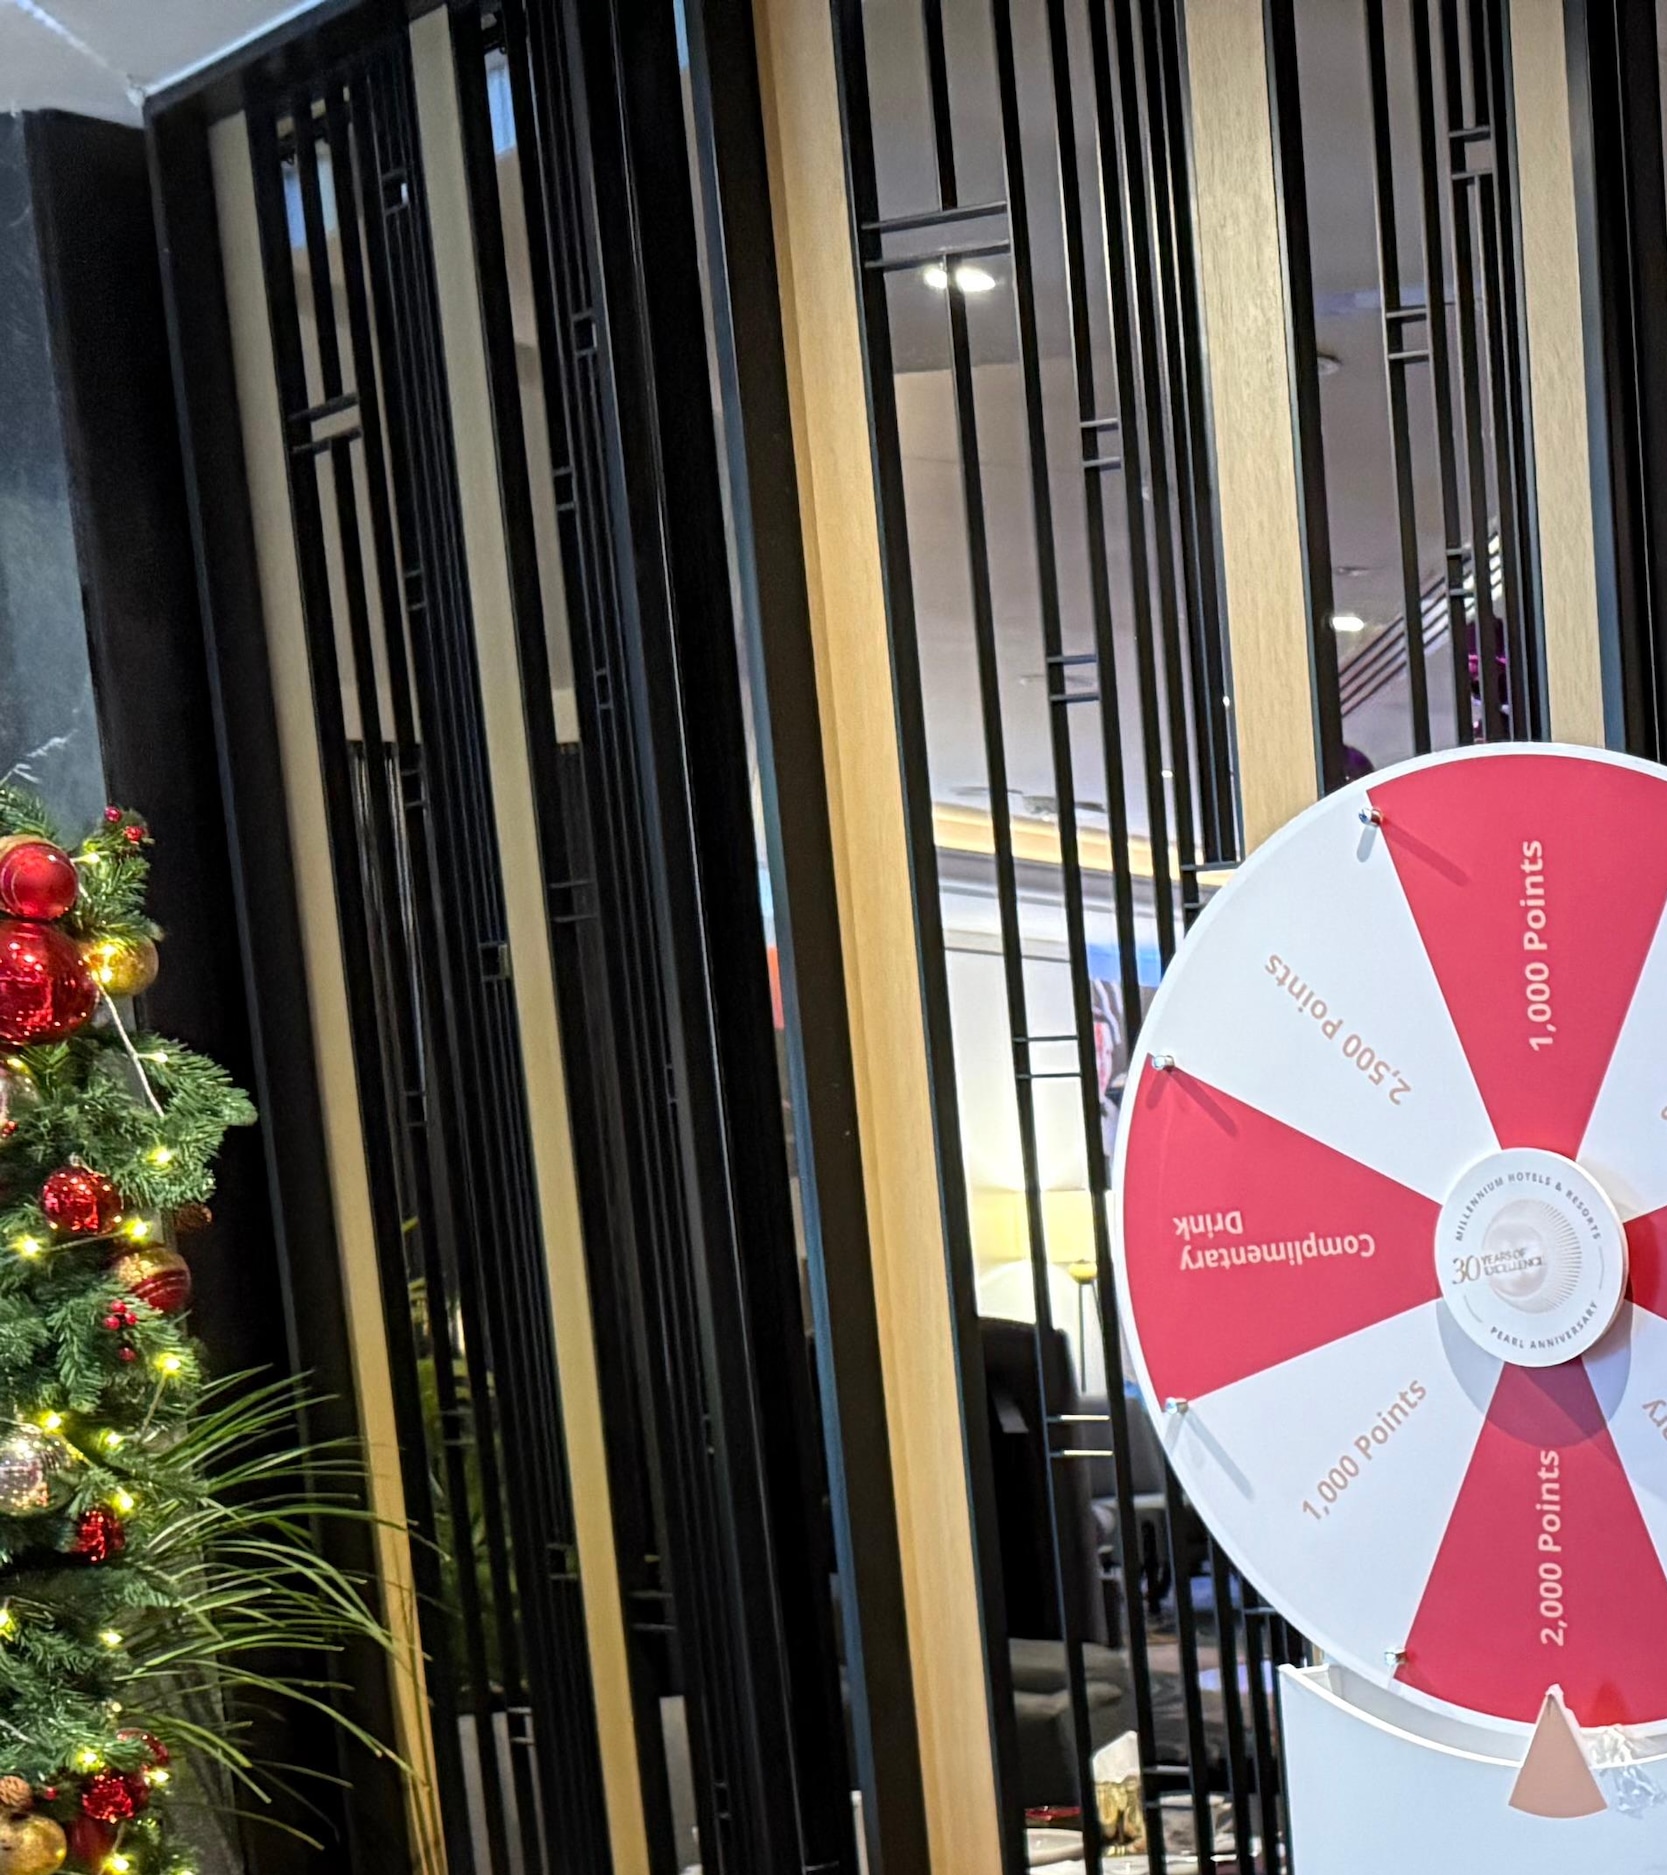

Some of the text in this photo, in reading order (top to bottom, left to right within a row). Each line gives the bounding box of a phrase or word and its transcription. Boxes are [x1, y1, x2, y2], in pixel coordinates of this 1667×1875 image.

[1521, 840, 1556, 1052] 1,000 Points
[1264, 954, 1413, 1105] 2,500 Points
[1173, 1209, 1244, 1240] Drink
[1455, 1177, 1505, 1241] MILLENNIUM
[1508, 1171, 1552, 1186] HOTELS
[1565, 1190, 1601, 1240] RESORTS
[1179, 1231, 1376, 1271] Complimentary
[1452, 1254, 1481, 1285] 30
[1490, 1301, 1599, 1350] PEARL ANNIVERSARY
[1301, 1379, 1427, 1521] 1,000 Points
[1535, 1450, 1565, 1647] 2,000 Points
